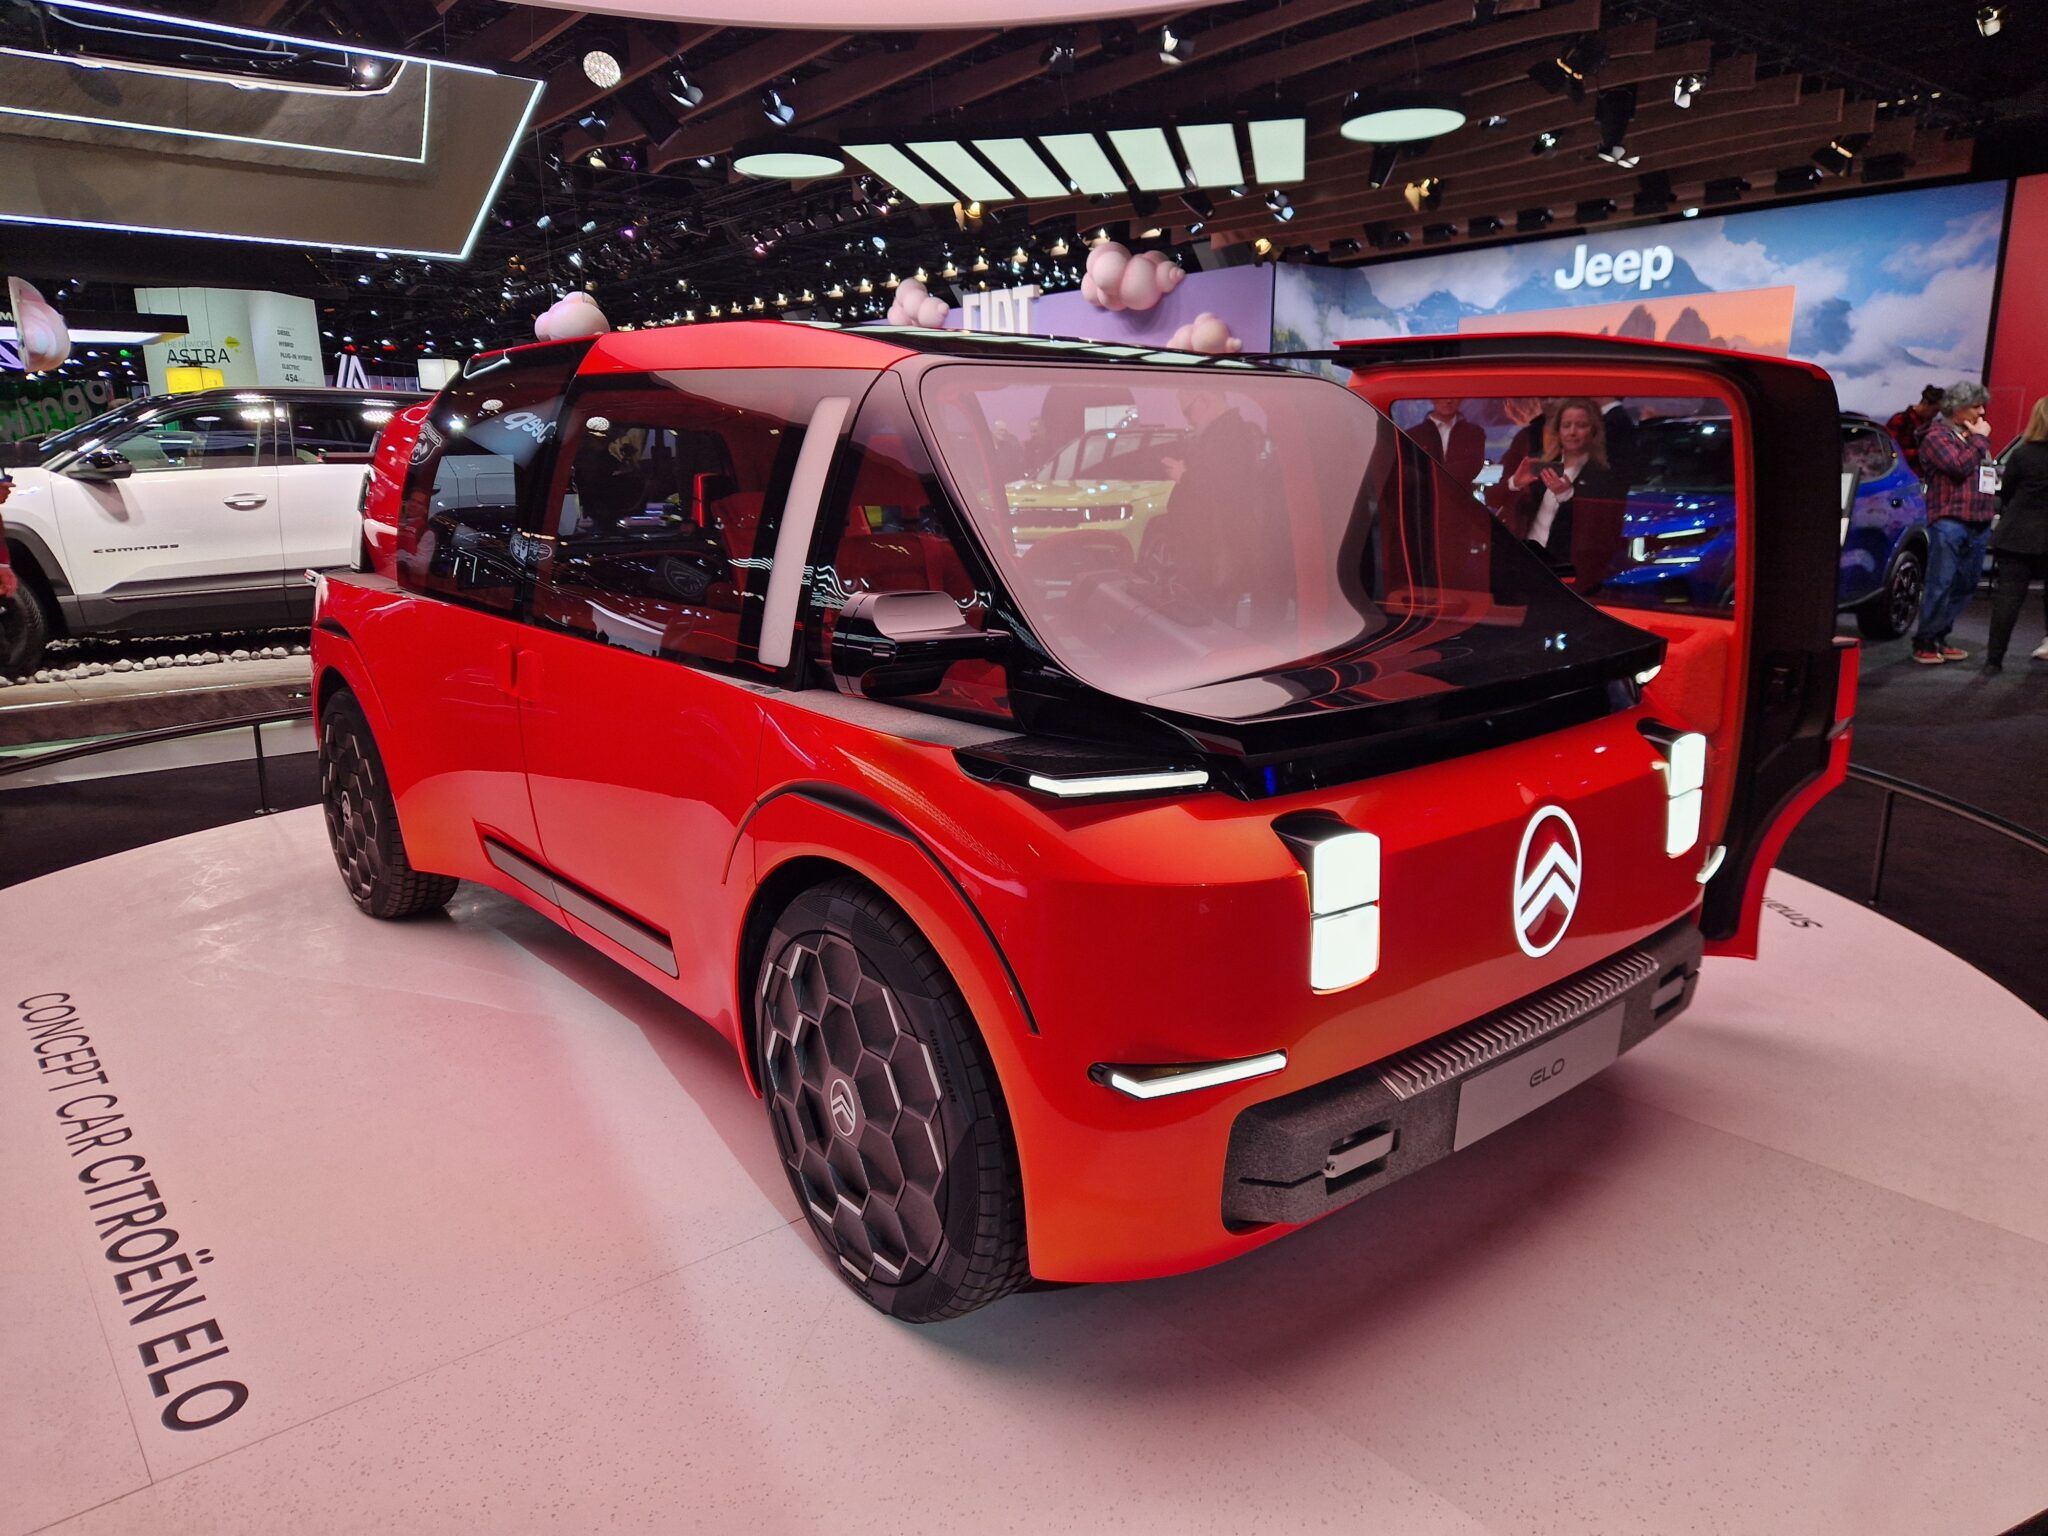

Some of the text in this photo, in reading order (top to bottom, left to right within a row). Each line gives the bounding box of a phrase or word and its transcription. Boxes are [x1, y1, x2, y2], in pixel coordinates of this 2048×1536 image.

[1554, 244, 1674, 290] Jeep
[963, 284, 1040, 334] FIAT
[167, 348, 231, 364] ASTRA
[285, 373, 299, 382] 454
[93, 544, 179, 554] COMPASS
[1530, 1058, 1565, 1087] ELO
[17, 992, 249, 1432] CONCEPT CAR CITROËN ELO
